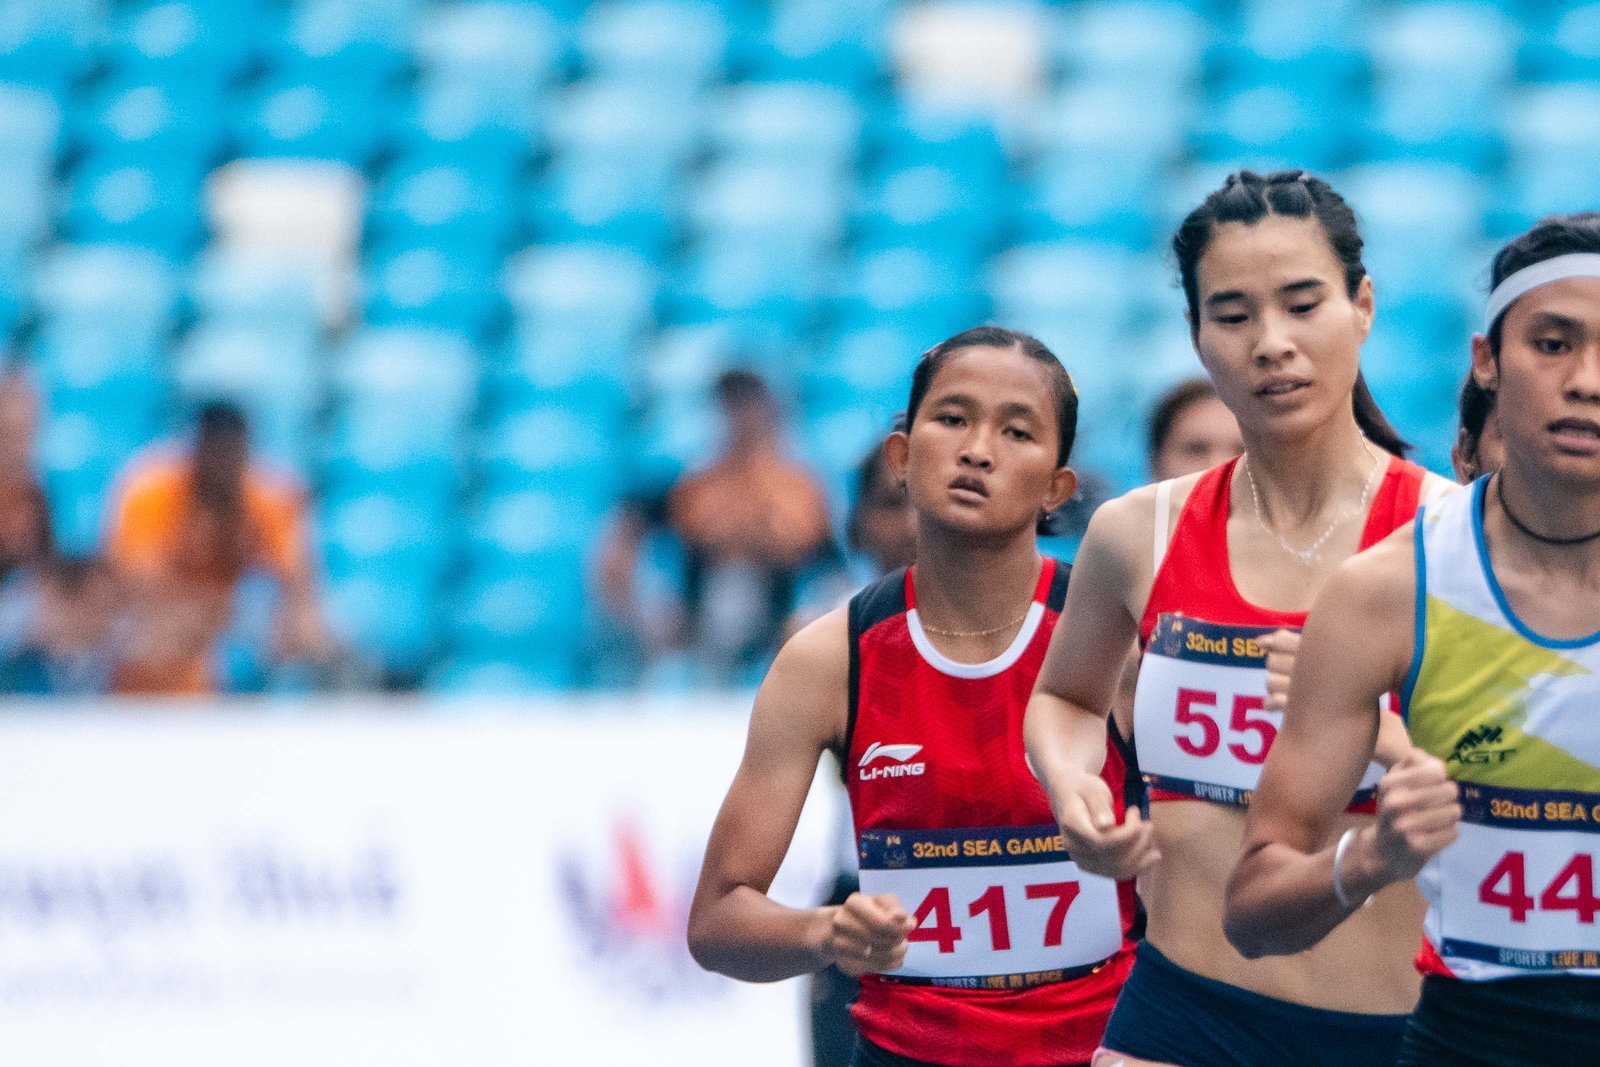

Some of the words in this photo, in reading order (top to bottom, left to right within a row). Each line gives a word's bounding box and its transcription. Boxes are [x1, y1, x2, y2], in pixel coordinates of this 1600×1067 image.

[1186, 631, 1228, 655] 32nd
[1173, 687, 1279, 765] 55
[859, 762, 925, 780] LI-NING
[1490, 799, 1539, 820] 32nd
[1544, 801, 1587, 821] SEA
[912, 841, 959, 858] 32nd
[963, 839, 1002, 857] SEA
[1006, 835, 1066, 855] GAME
[906, 880, 1081, 954] 417
[1499, 949, 1547, 967] SPORTS
